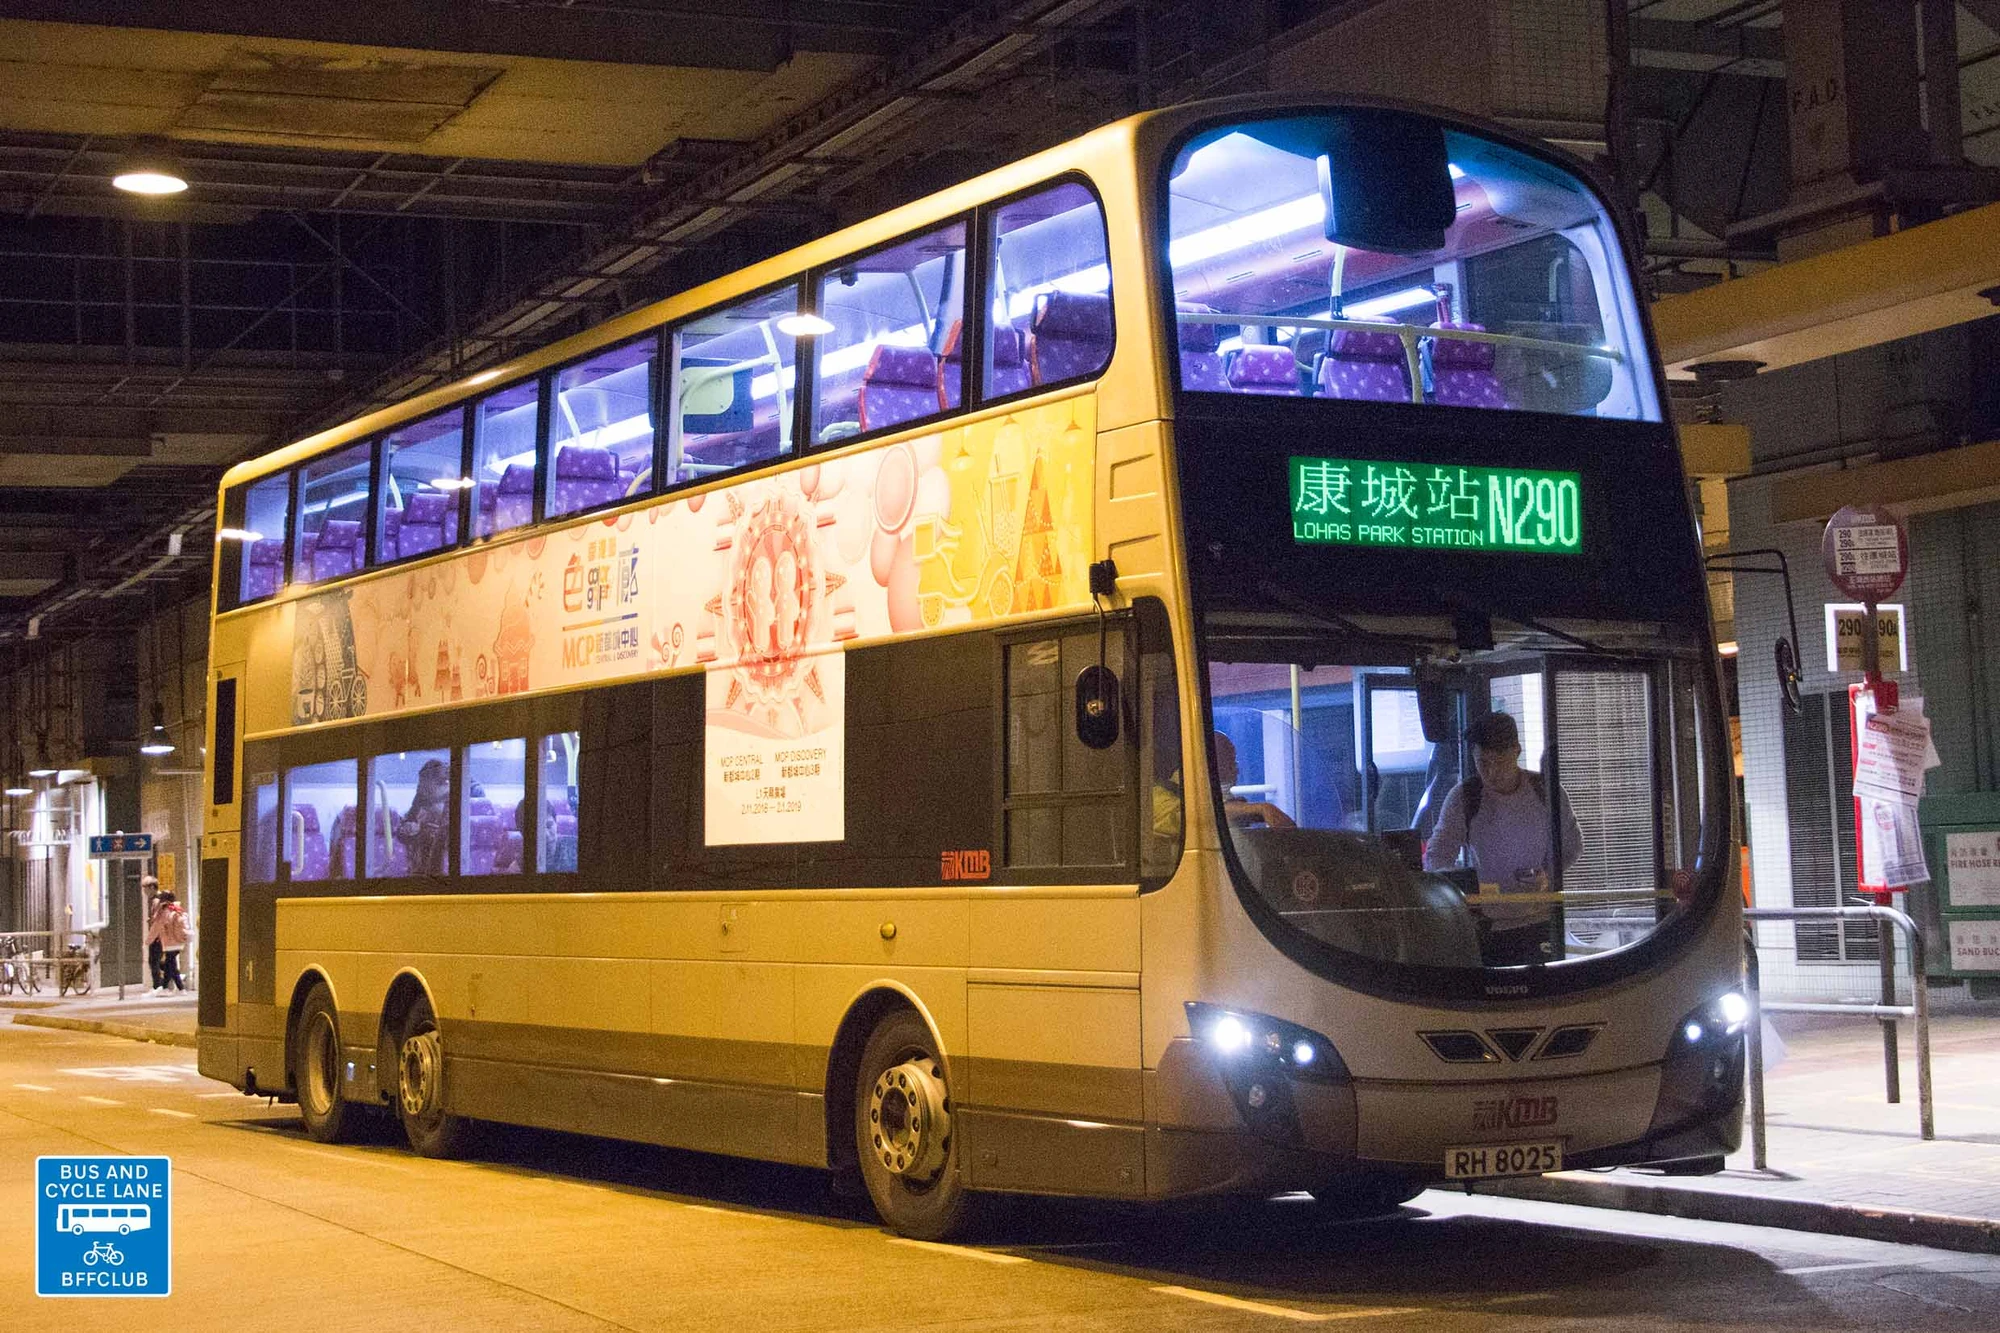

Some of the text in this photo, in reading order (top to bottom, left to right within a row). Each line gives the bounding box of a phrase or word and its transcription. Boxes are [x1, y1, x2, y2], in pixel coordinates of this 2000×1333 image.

[1295, 460, 1481, 520] 康城站
[1488, 475, 1579, 546] N290
[1293, 521, 1484, 546] LOHAS PARK STATION
[1838, 618, 1862, 637] 290
[1878, 618, 1898, 637] 90A
[562, 633, 595, 670] MCP
[720, 754, 764, 768] MCP CENTRAL
[774, 748, 827, 763] MCP DISCOVERY
[1950, 859, 1967, 870] FIRE
[1969, 858, 1992, 869] HOSE
[1957, 946, 1981, 957] SAND
[1454, 1145, 1557, 1176] RH 8025
